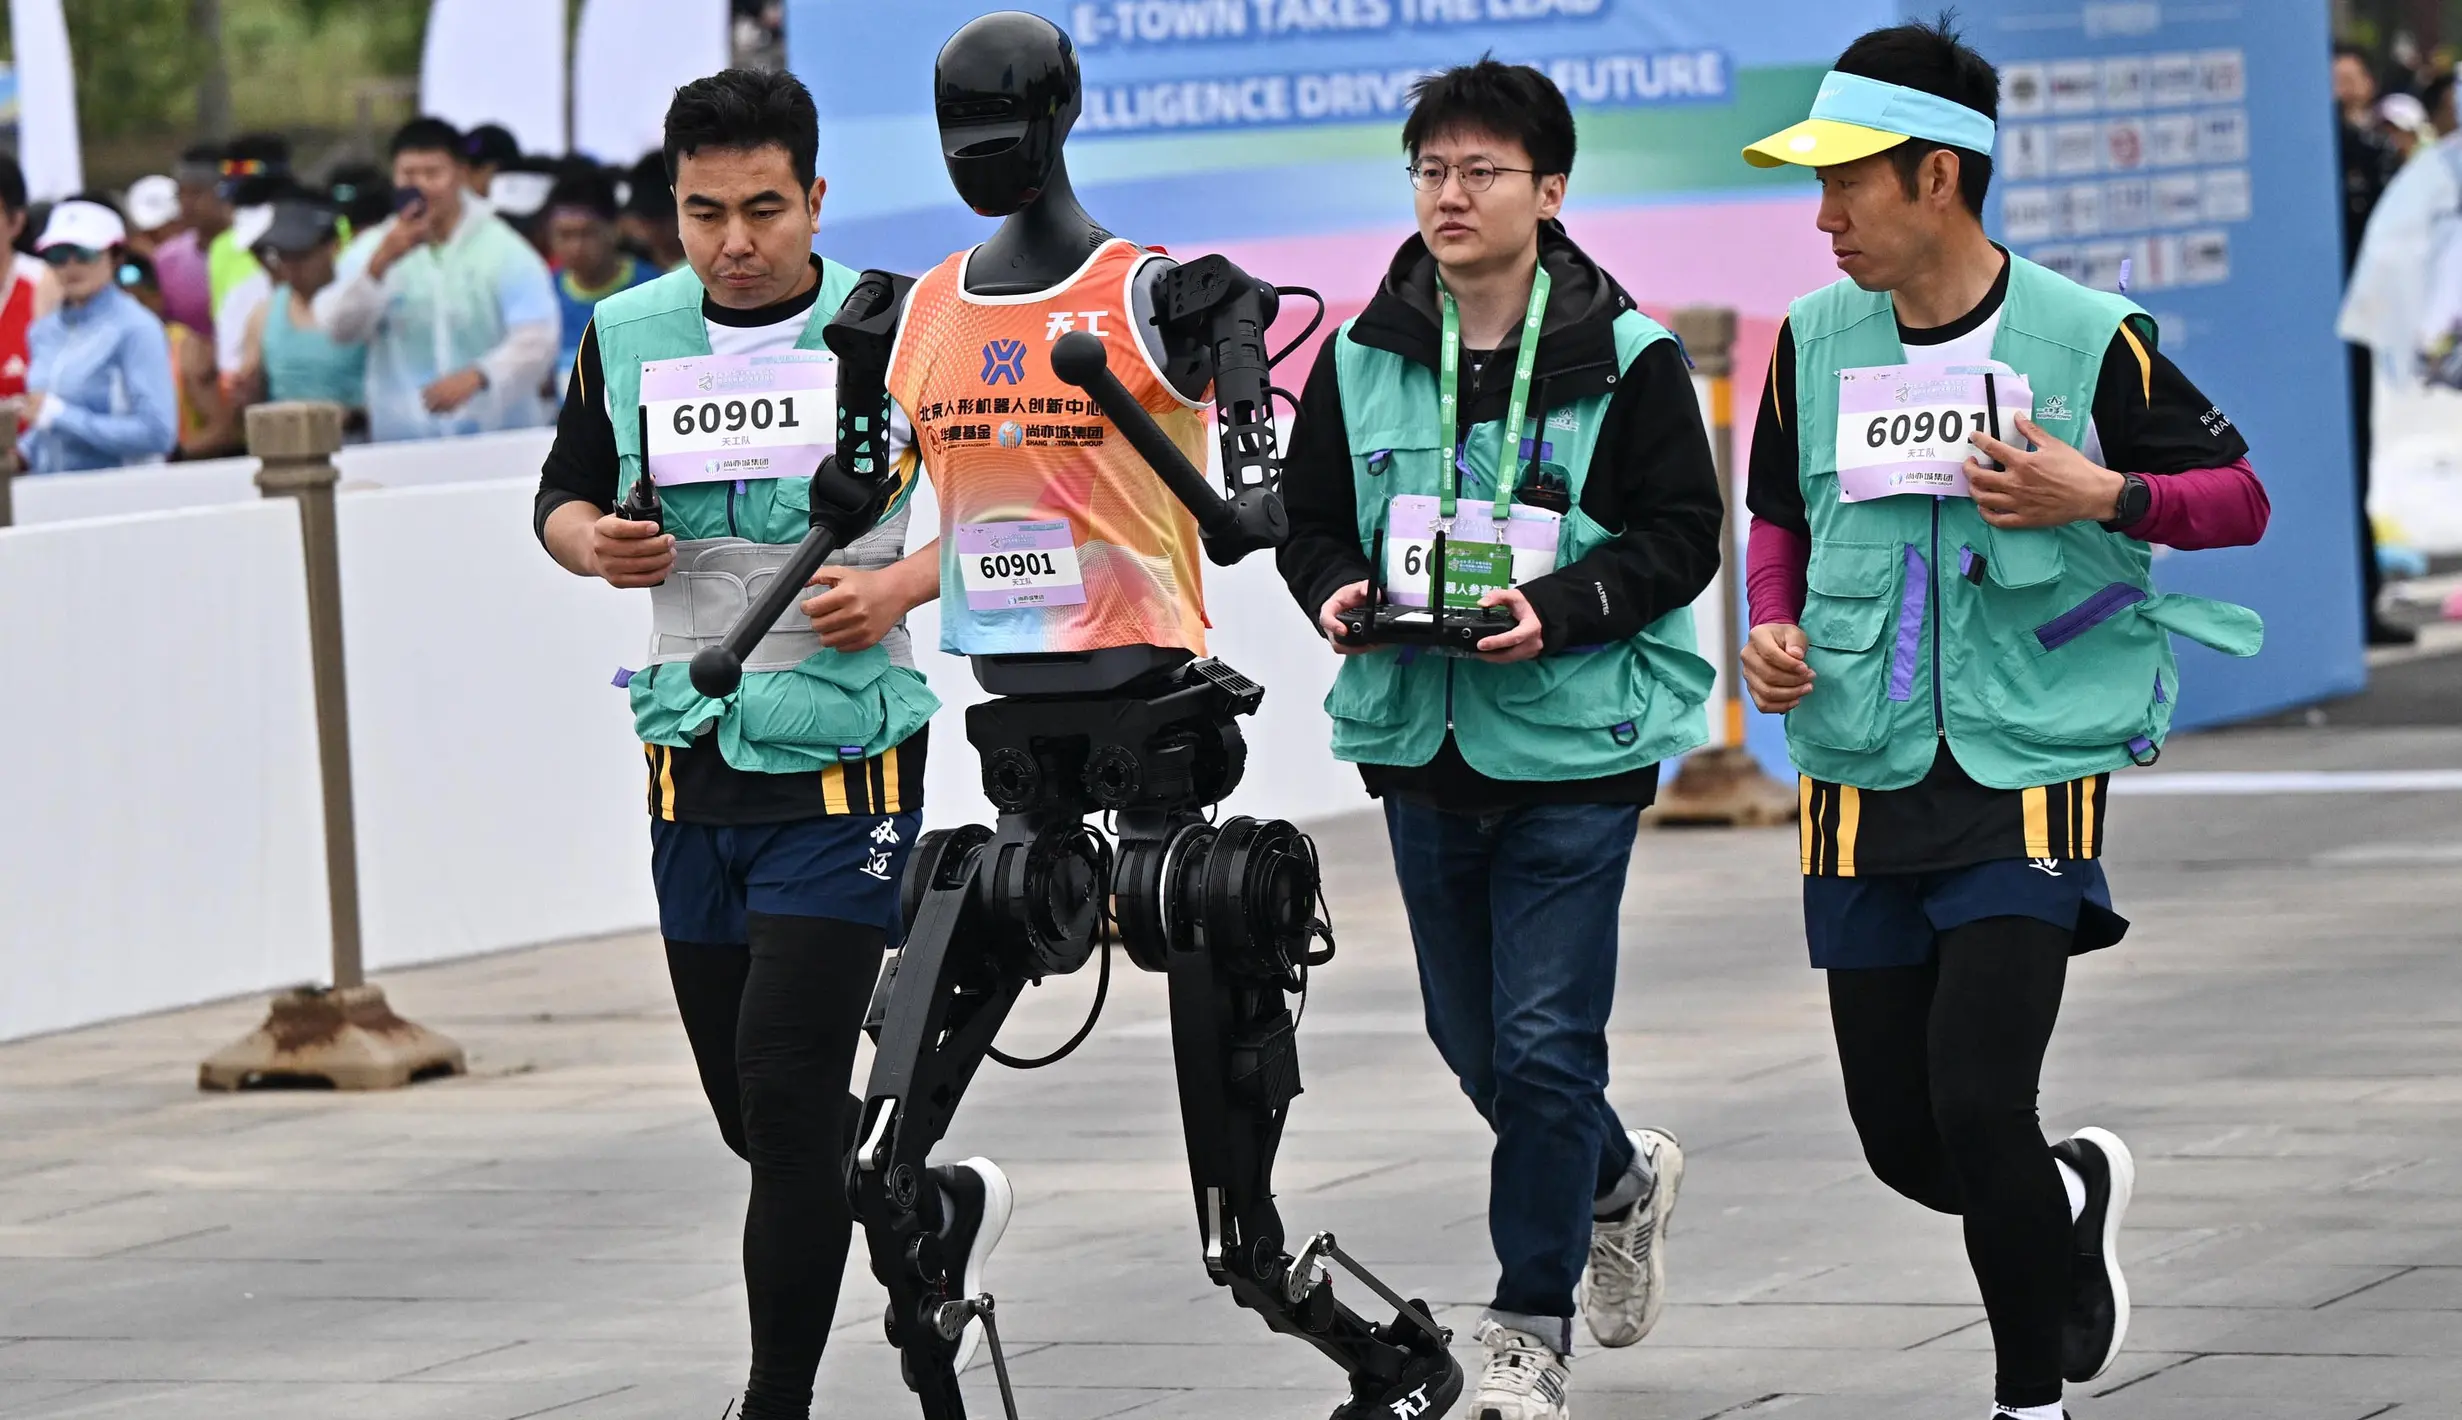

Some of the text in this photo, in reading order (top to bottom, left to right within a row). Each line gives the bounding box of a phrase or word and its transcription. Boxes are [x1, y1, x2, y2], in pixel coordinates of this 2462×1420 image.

[1073, 0, 1247, 45] E-TOWN
[1551, 51, 1728, 101] FUTURE
[1045, 310, 1110, 341] 天工
[673, 397, 799, 435] 60901
[1026, 424, 1104, 439] 尚亦城集团
[1866, 410, 1986, 448] 60901
[721, 436, 751, 447] 天工队
[1907, 448, 1936, 459] 天工队
[980, 553, 1056, 579] 60901
